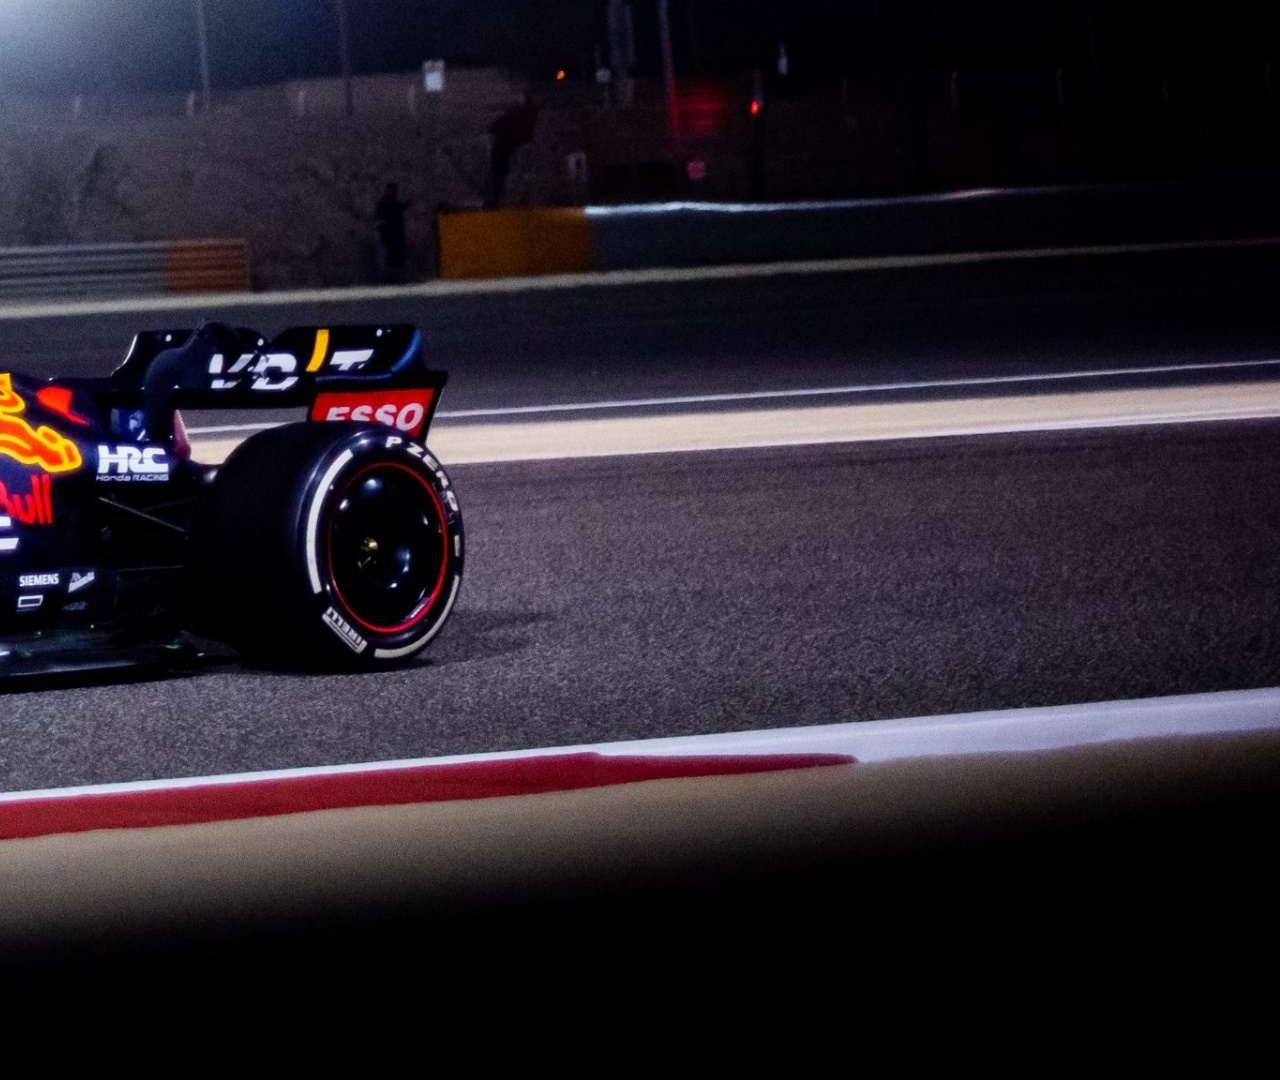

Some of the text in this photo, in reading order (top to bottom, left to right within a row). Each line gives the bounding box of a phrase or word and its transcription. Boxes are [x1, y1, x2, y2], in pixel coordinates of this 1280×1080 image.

[97, 445, 169, 474] HRC
[96, 474, 169, 482] Honda RACING
[385, 436, 458, 511] P ZERO
[19, 573, 59, 587] SIEMENS
